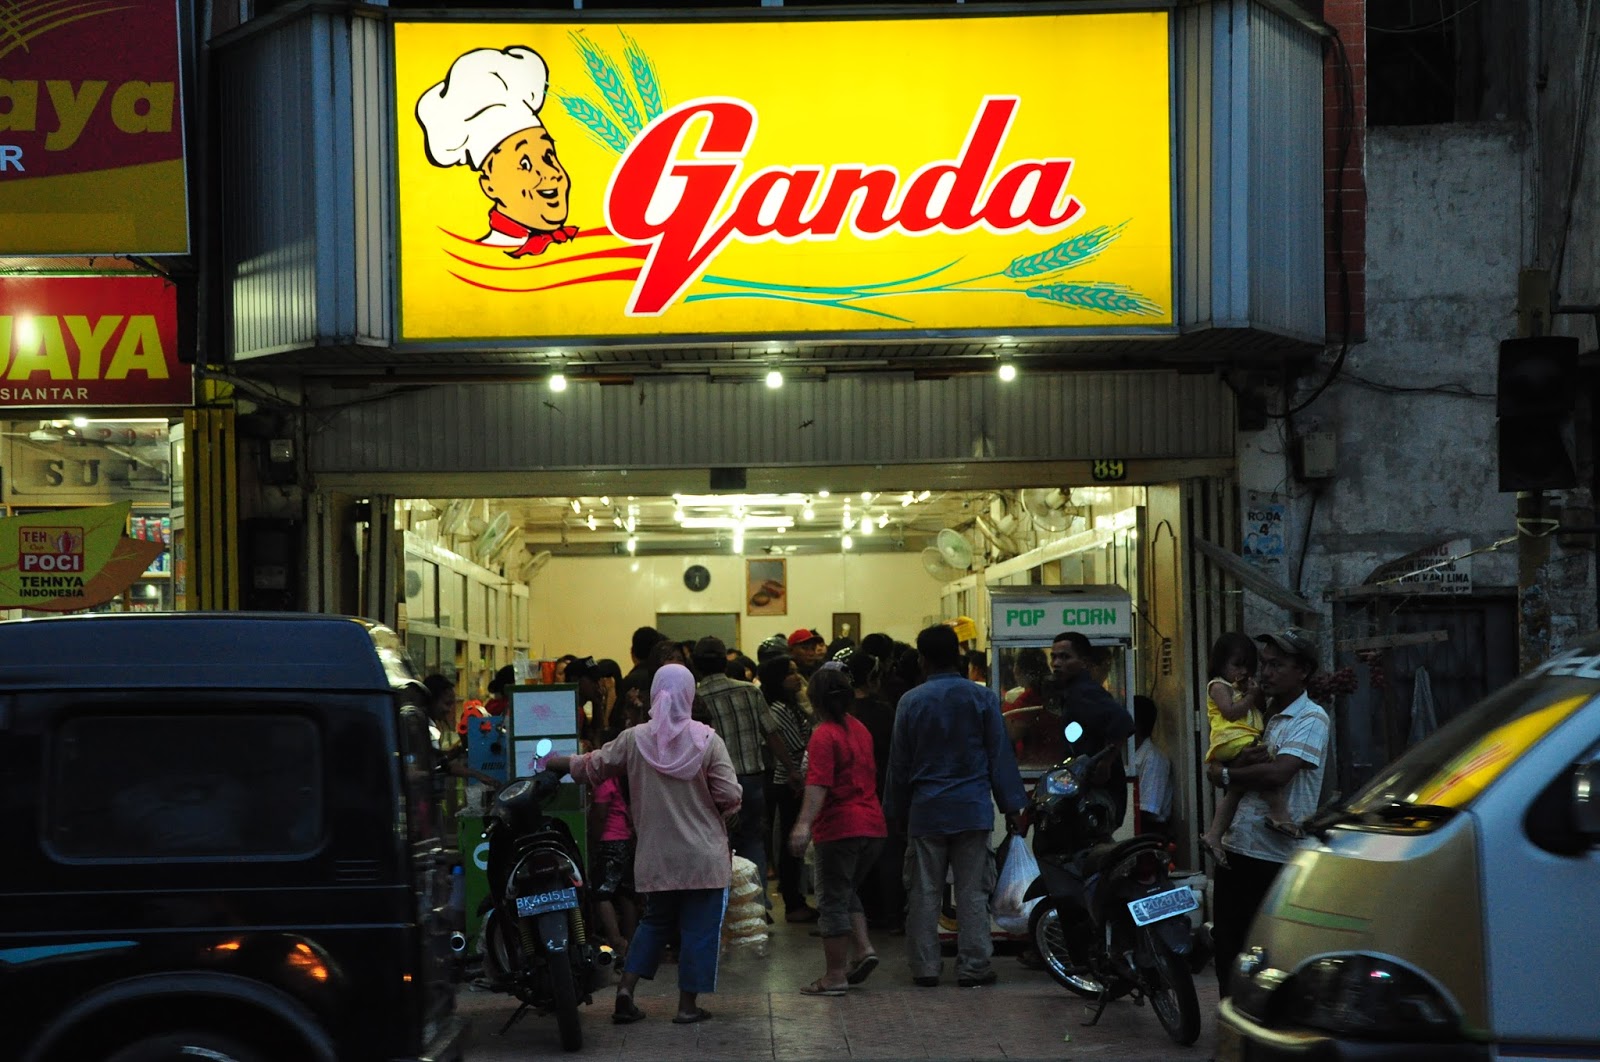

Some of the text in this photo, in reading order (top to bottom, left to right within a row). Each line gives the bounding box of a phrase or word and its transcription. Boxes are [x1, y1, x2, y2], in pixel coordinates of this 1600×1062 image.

[604, 95, 1085, 317] Ganda
[1094, 459, 1124, 479] 89
[1248, 512, 1281, 521] RODA
[22, 532, 47, 543] TEH
[24, 555, 79, 570] POCI
[20, 577, 84, 587] TEHNYA
[1447, 574, 1469, 583] LIMA
[20, 589, 84, 597] INDONESIA
[1006, 608, 1117, 627] POP CORN
[517, 887, 577, 909] BK 4615 LT
